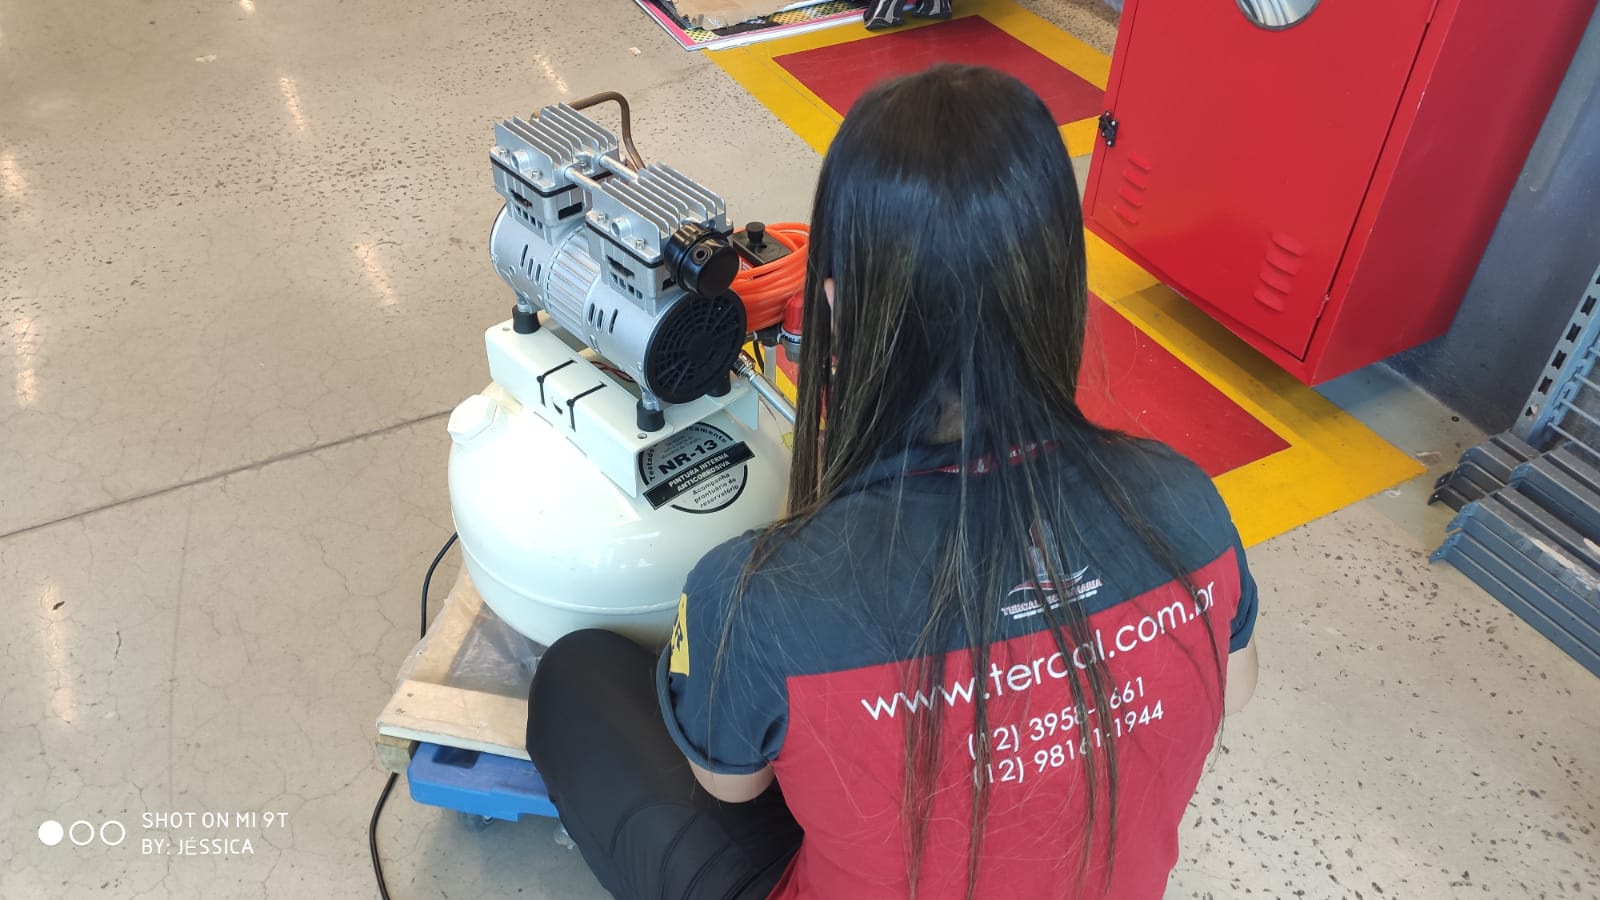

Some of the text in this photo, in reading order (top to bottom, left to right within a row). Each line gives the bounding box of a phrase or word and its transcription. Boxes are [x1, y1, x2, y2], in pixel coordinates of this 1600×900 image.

[658, 439, 718, 475] NR-13
[668, 452, 729, 487] PINTURA INTERNA
[677, 460, 731, 492] ANTICORROSIVA
[861, 581, 1214, 720] www.tercal.com.br
[1029, 676, 1145, 741] 3958-661
